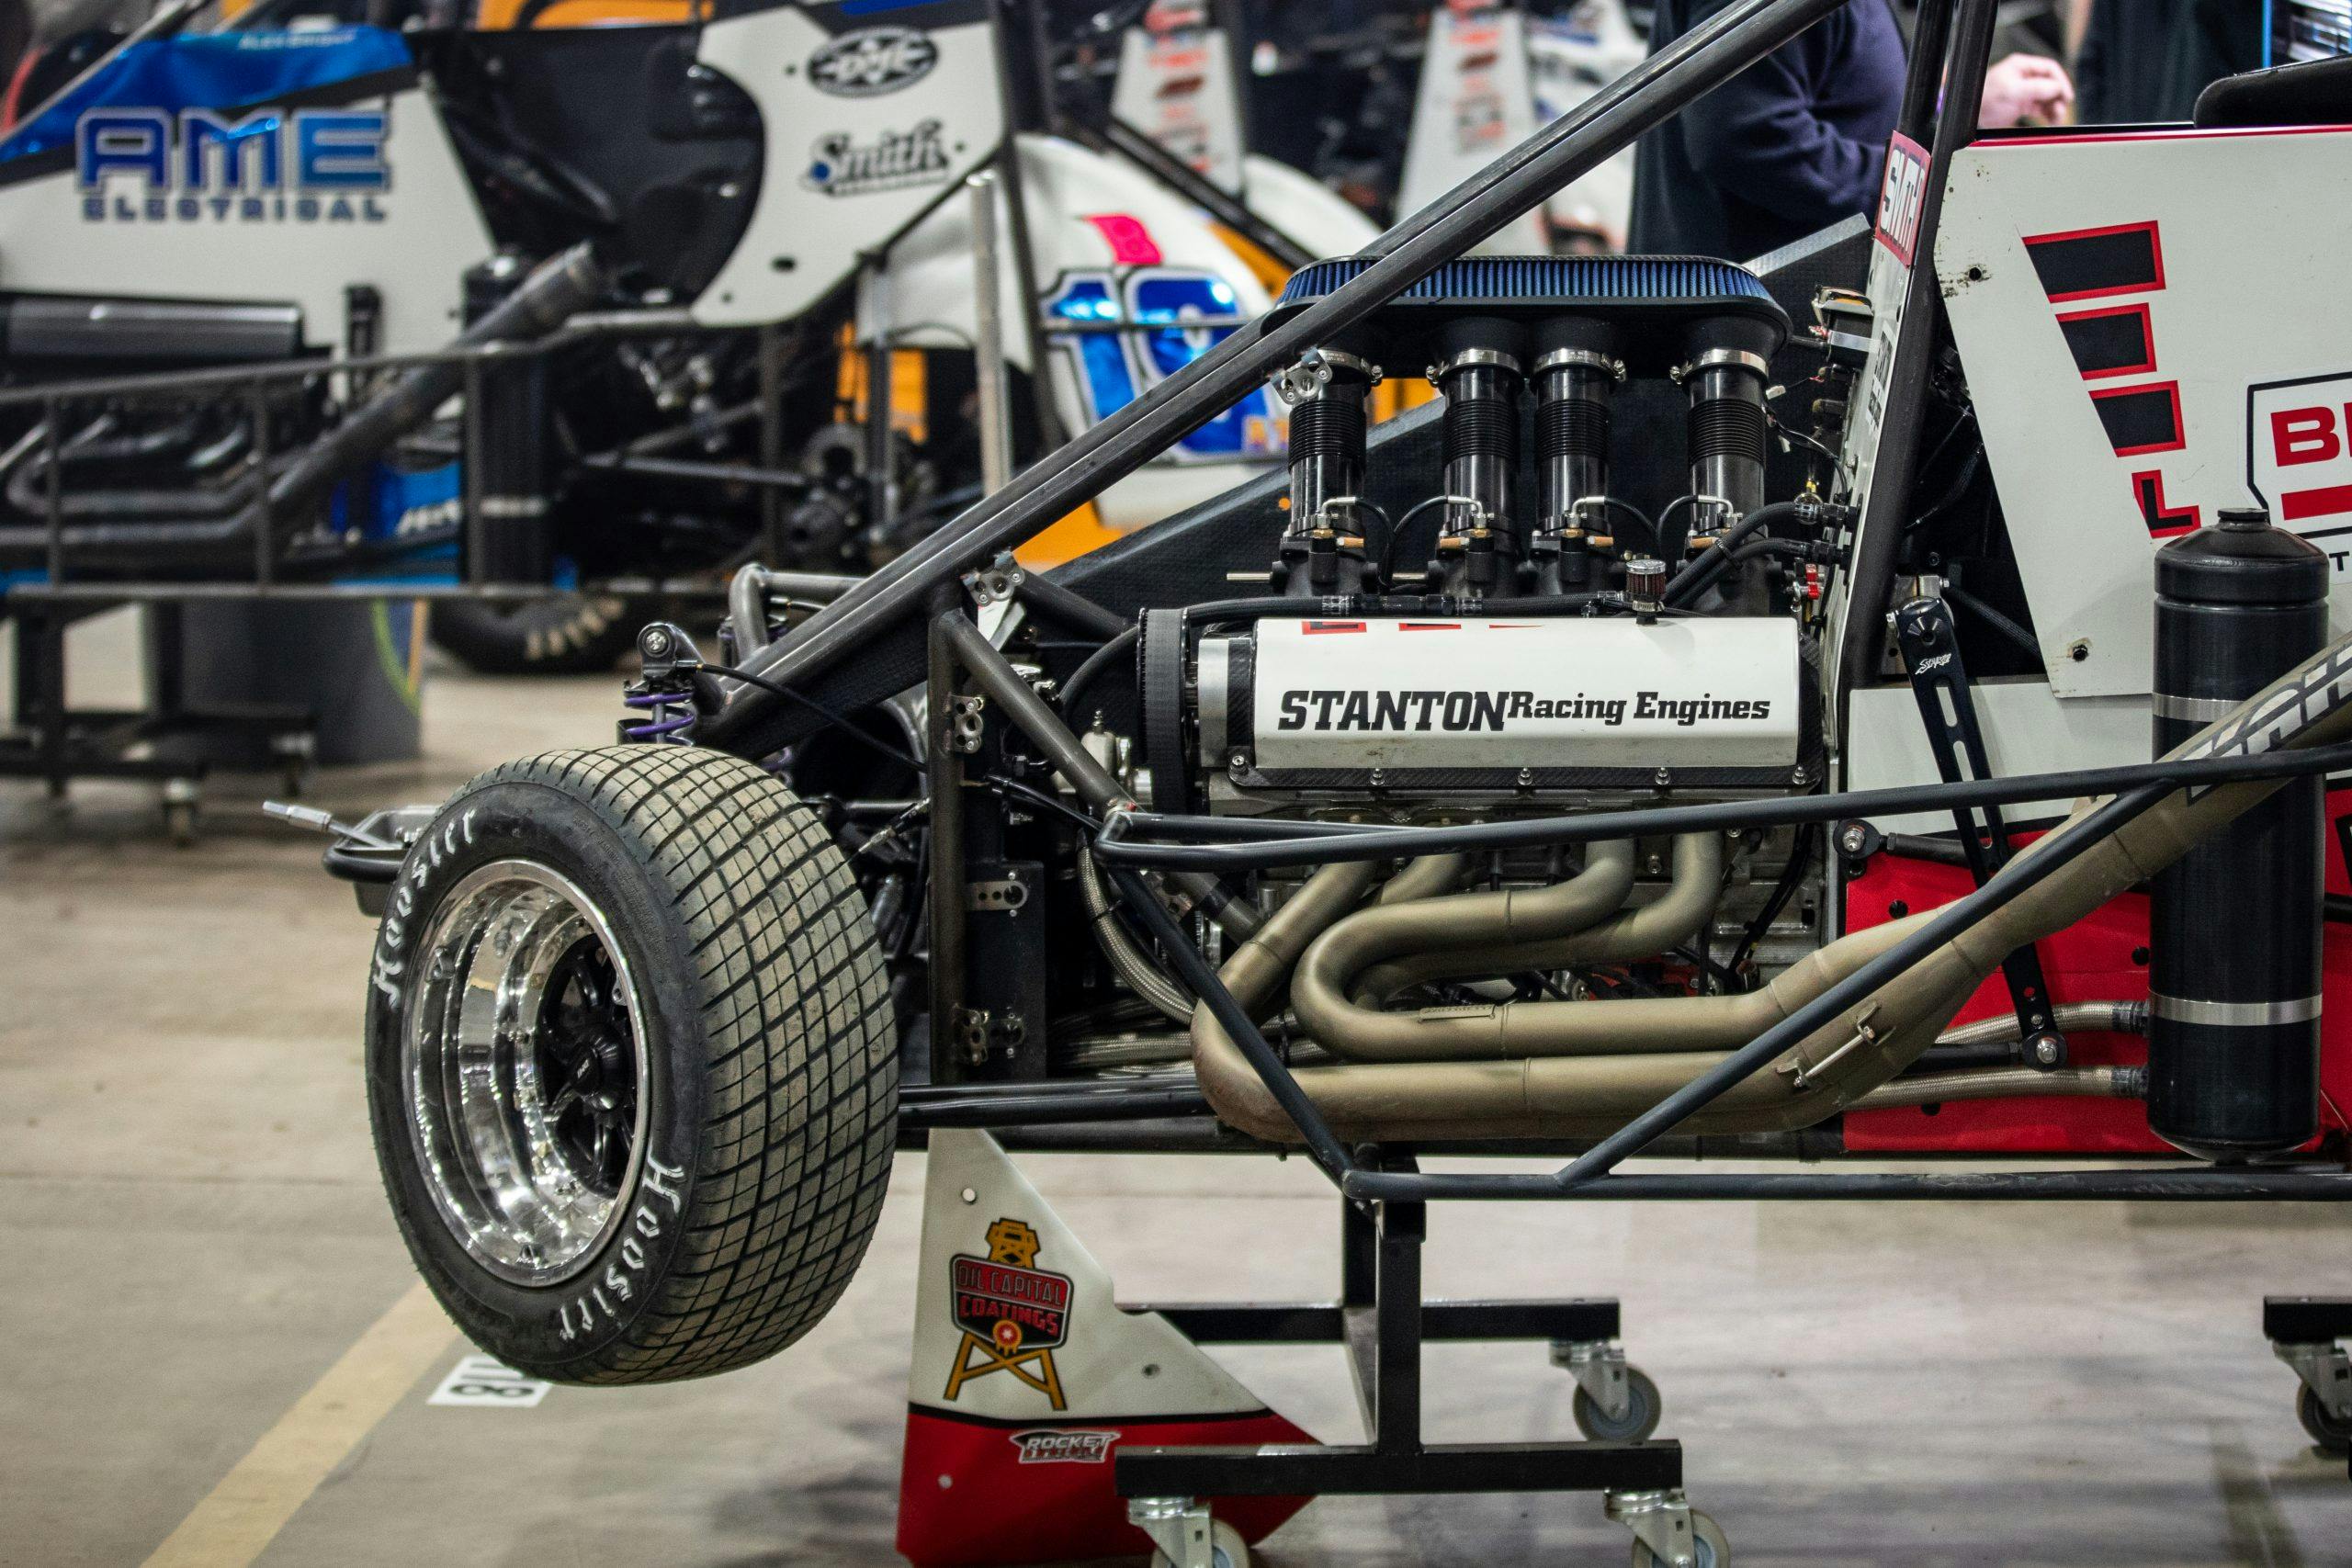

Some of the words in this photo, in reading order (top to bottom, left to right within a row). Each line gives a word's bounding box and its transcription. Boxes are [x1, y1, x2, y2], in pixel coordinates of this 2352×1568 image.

[75, 107, 392, 195] AME
[83, 197, 387, 222] ELECTRICAL
[2270, 406, 2352, 467] B
[1278, 690, 1510, 731] STANTON
[1507, 691, 1627, 726] Racing
[1633, 691, 1770, 727] Engines
[958, 1265, 984, 1290] OIL
[990, 1272, 1062, 1305] CAPITAL
[958, 1294, 1059, 1337] COATINGS
[1027, 1434, 1113, 1453] ROCKET
